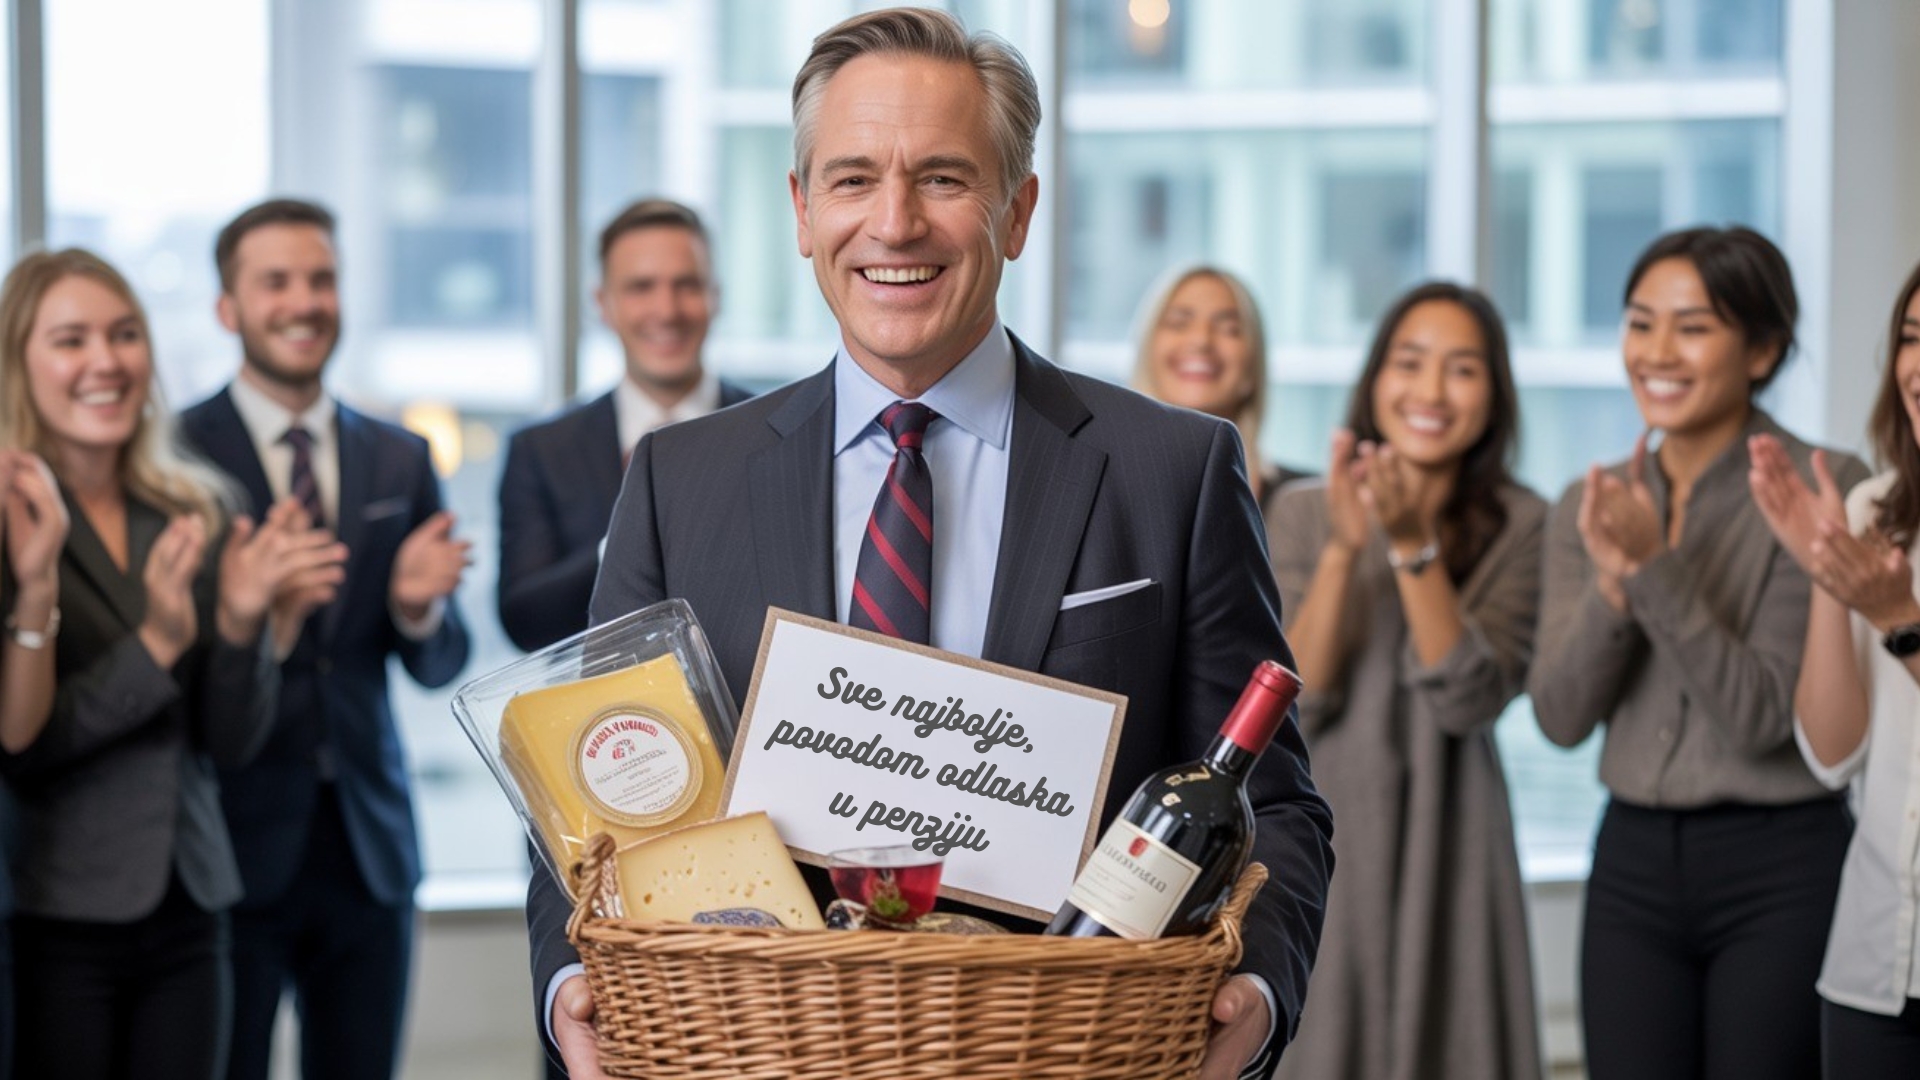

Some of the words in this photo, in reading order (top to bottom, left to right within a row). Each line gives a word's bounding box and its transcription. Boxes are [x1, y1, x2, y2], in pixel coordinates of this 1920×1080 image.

[817, 666, 887, 712] Sve
[889, 694, 1034, 754] najbolje,
[763, 719, 931, 780] povodom
[935, 760, 1075, 817] odlaska
[828, 791, 859, 818] u
[855, 800, 991, 857] penziju
